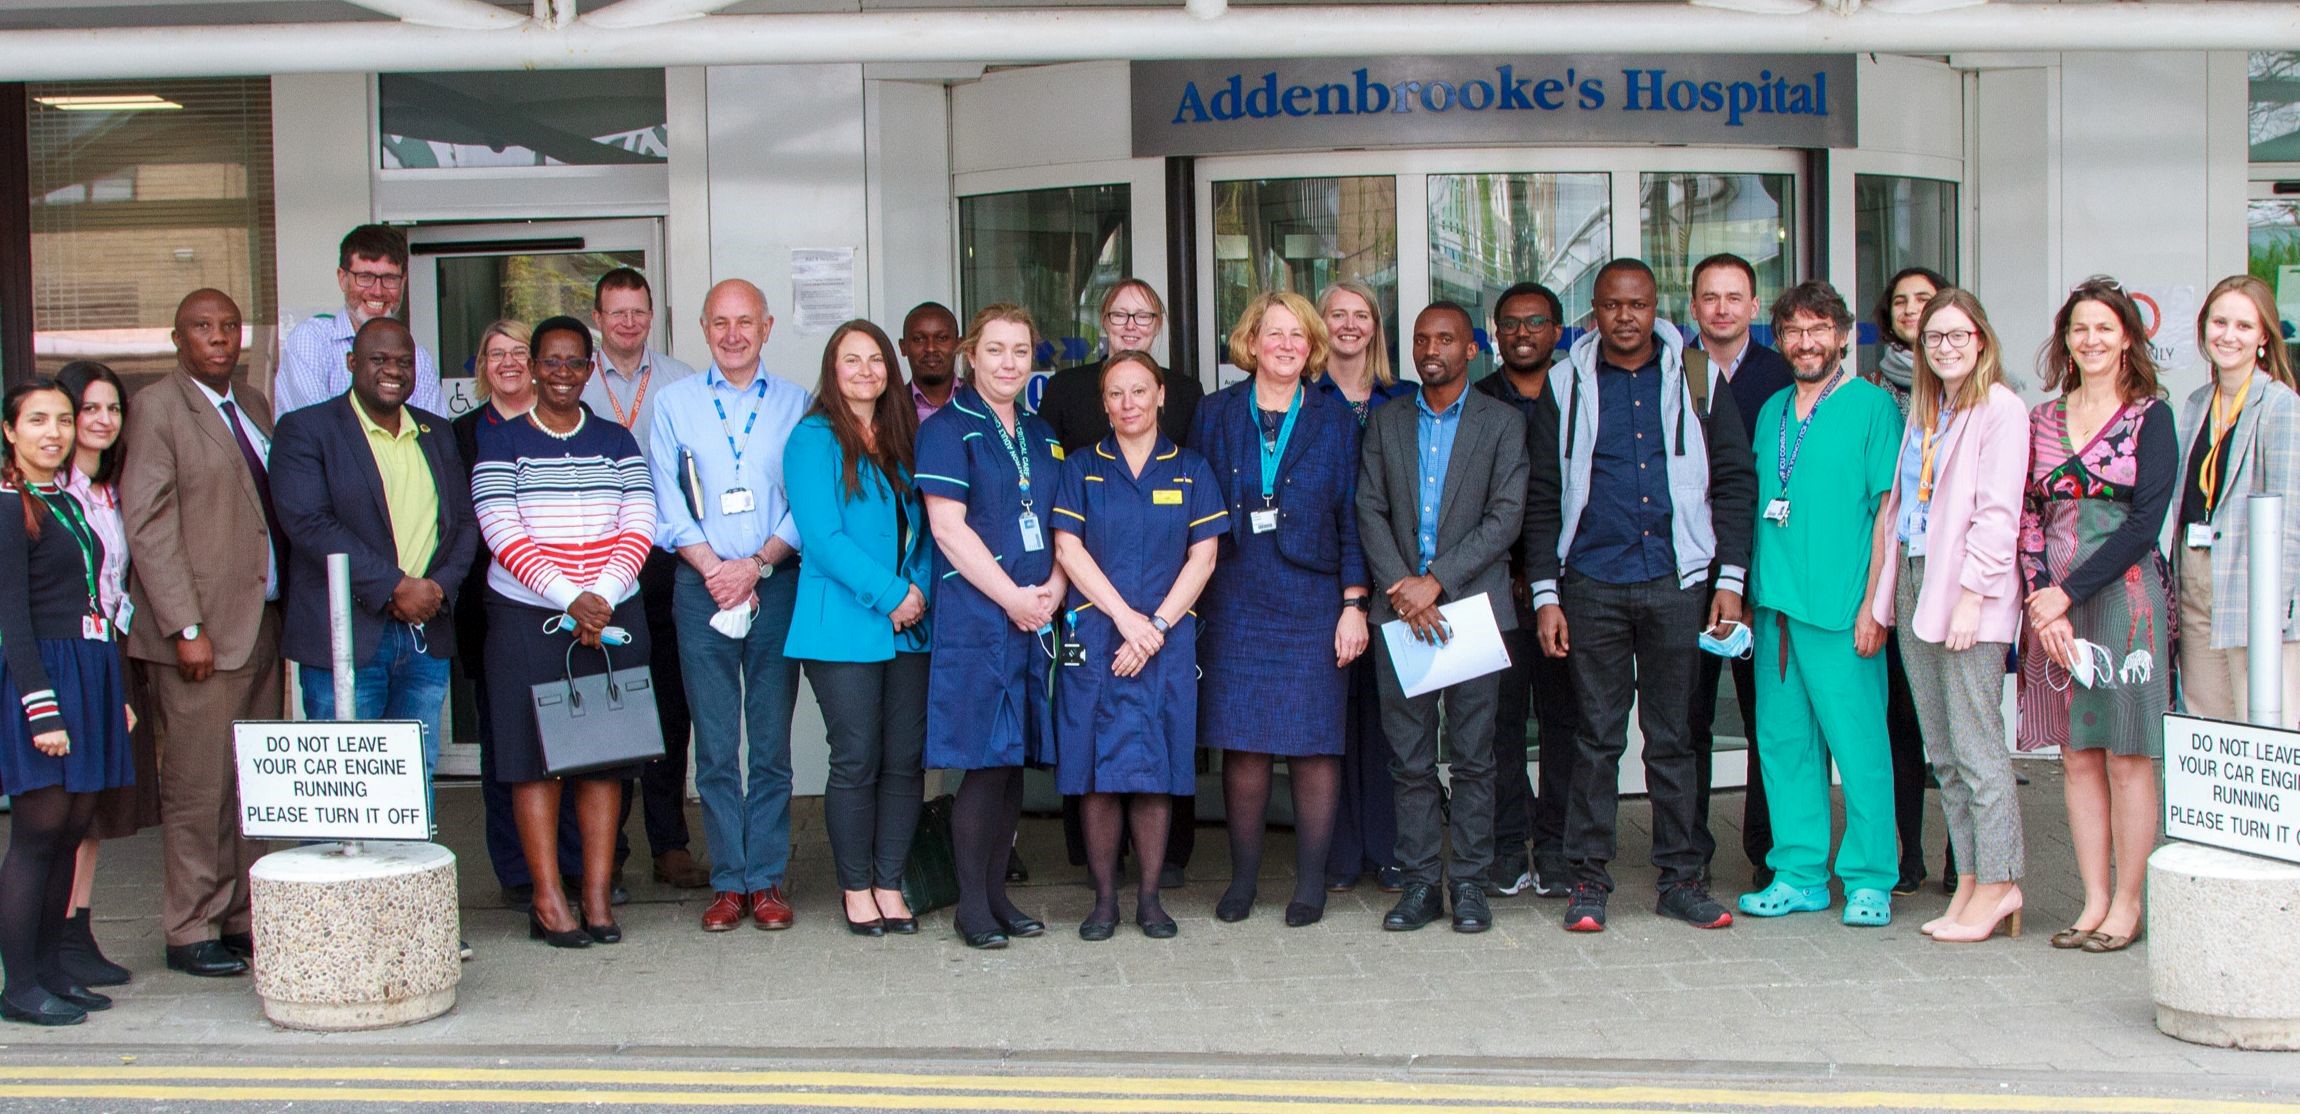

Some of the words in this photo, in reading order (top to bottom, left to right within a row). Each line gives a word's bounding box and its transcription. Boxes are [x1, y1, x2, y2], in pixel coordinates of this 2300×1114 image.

[1171, 64, 1605, 124] Addenbrooke's
[1621, 68, 1829, 127] Hospital
[998, 428, 1013, 450] ADULT
[1799, 425, 1809, 438] ICU
[1016, 427, 1027, 455] CRITICAL
[1022, 457, 1030, 477] CARE
[1779, 457, 1787, 470] ICU
[1010, 450, 1024, 480] MATRON
[267, 736, 290, 752] DO
[298, 736, 330, 752] NOT
[337, 736, 388, 753] LEAVE
[2192, 733, 2213, 752] DO
[2219, 737, 2249, 757] NOT
[2256, 742, 2300, 766] LEAVE
[253, 758, 297, 774] YOUR
[304, 758, 337, 775] CAR
[345, 759, 407, 775] ENGINE
[2178, 755, 2217, 777] YOUR
[2224, 762, 2254, 783] CAR
[2261, 768, 2300, 791] ENGI
[294, 781, 368, 797] RUNNING
[2213, 785, 2280, 812] RUNNING
[247, 806, 308, 823] PLEASE
[315, 807, 359, 823] TURN
[366, 808, 380, 824] IT
[388, 808, 420, 824] OFF
[2170, 805, 2224, 831] PLEASE
[2230, 816, 2270, 840] TURN
[2277, 825, 2290, 843] IT
